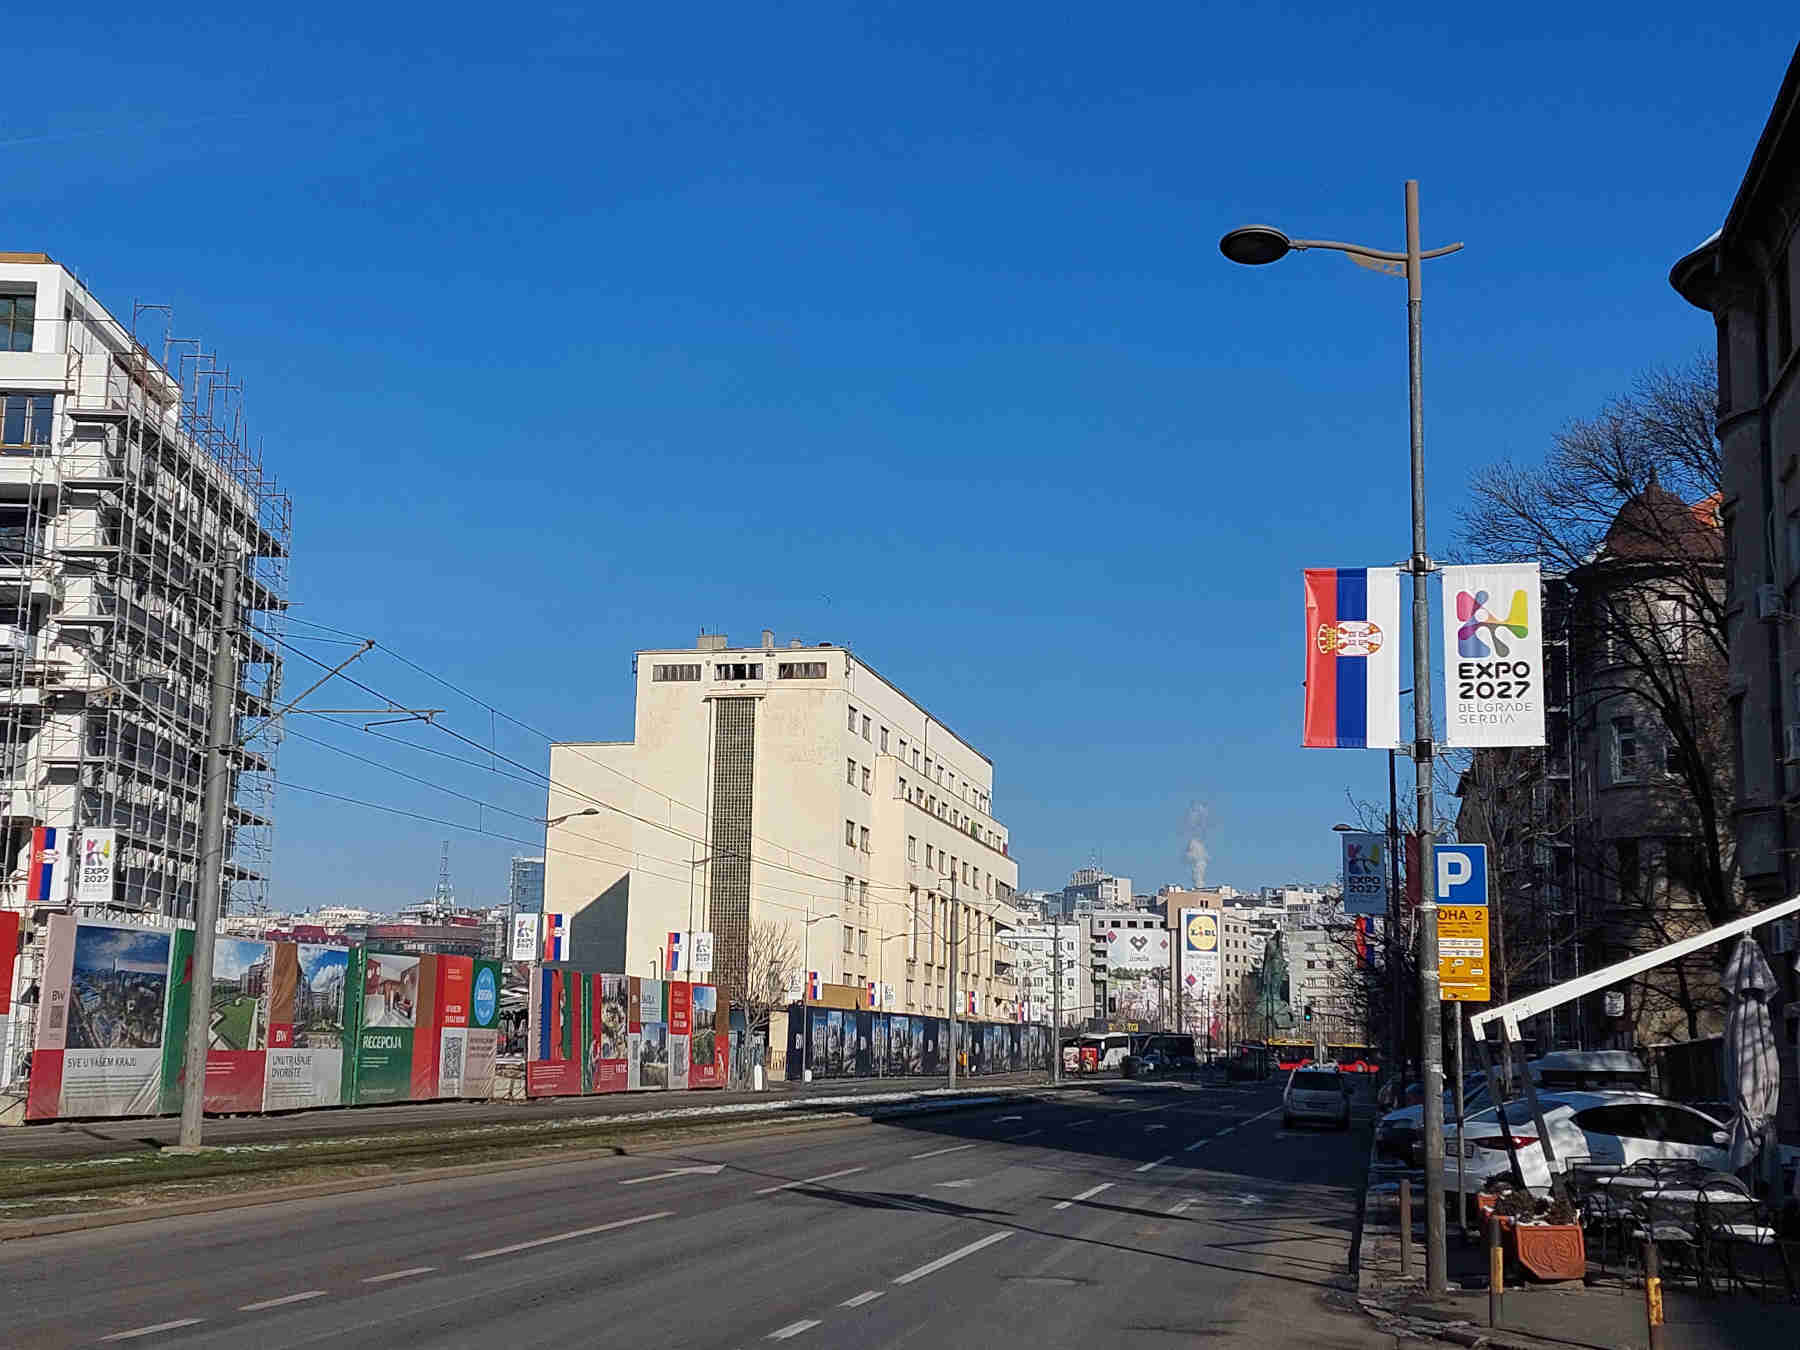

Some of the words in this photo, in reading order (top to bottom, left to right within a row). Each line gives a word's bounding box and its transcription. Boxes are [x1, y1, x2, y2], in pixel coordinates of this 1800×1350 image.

[1458, 661, 1531, 680] EXPO
[1458, 681, 1531, 700] 2027
[1458, 703, 1533, 713] BELGRADE
[1458, 714, 1515, 724] SERBIA
[84, 867, 110, 875] EXPO
[1437, 852, 1472, 897] P
[84, 875, 109, 883] 2027
[1348, 875, 1381, 884] EXPO
[1348, 884, 1381, 893] 2027
[1437, 910, 1468, 920] ОНА
[1474, 910, 1483, 920] 2
[363, 1035, 402, 1049] RECEPCIJA
[67, 1057, 83, 1068] SVE
